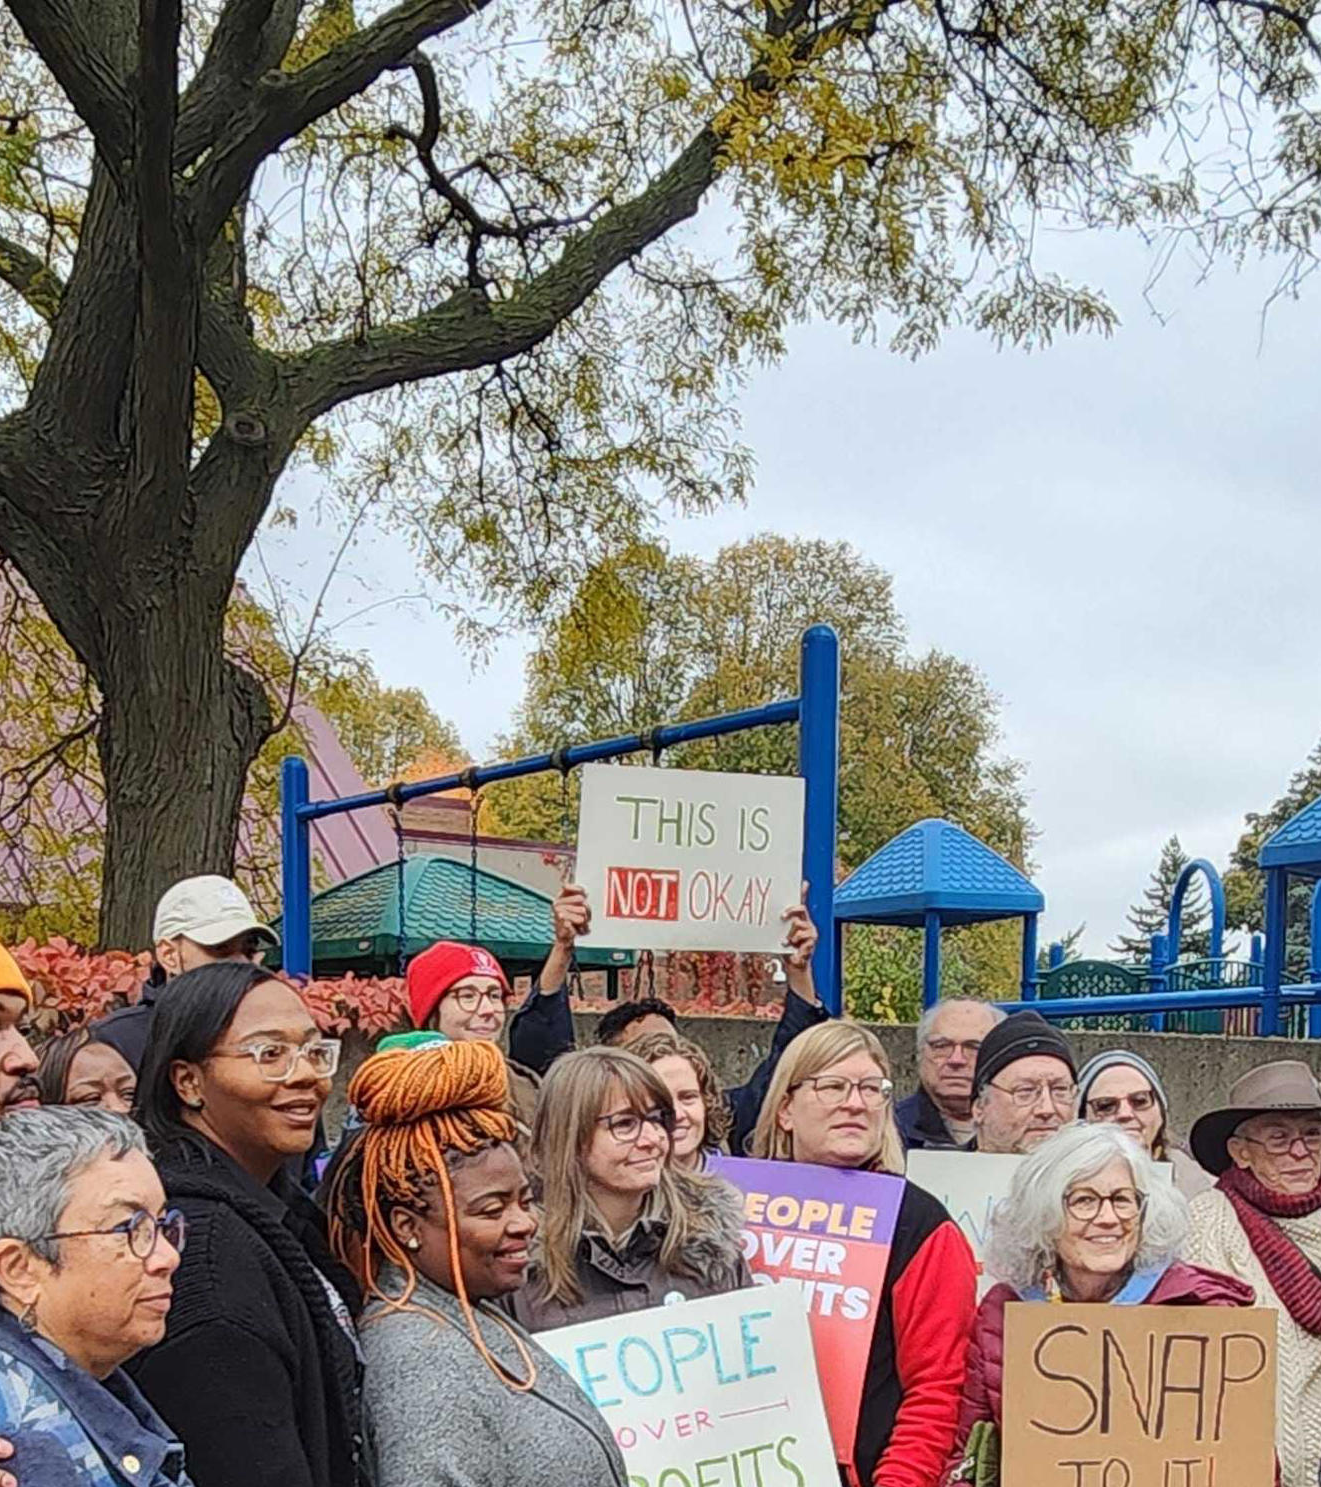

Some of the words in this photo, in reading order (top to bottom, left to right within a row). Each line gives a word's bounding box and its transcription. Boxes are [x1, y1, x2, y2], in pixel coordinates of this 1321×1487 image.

[615, 795, 716, 847] THIS
[738, 807, 771, 851] IS
[608, 868, 679, 920] NOT
[688, 870, 773, 926] OKAY
[744, 1192, 878, 1240] EOPLE
[555, 1311, 778, 1409] EOPLE
[1029, 1324, 1267, 1441] SNAP
[617, 1411, 715, 1449] OVER
